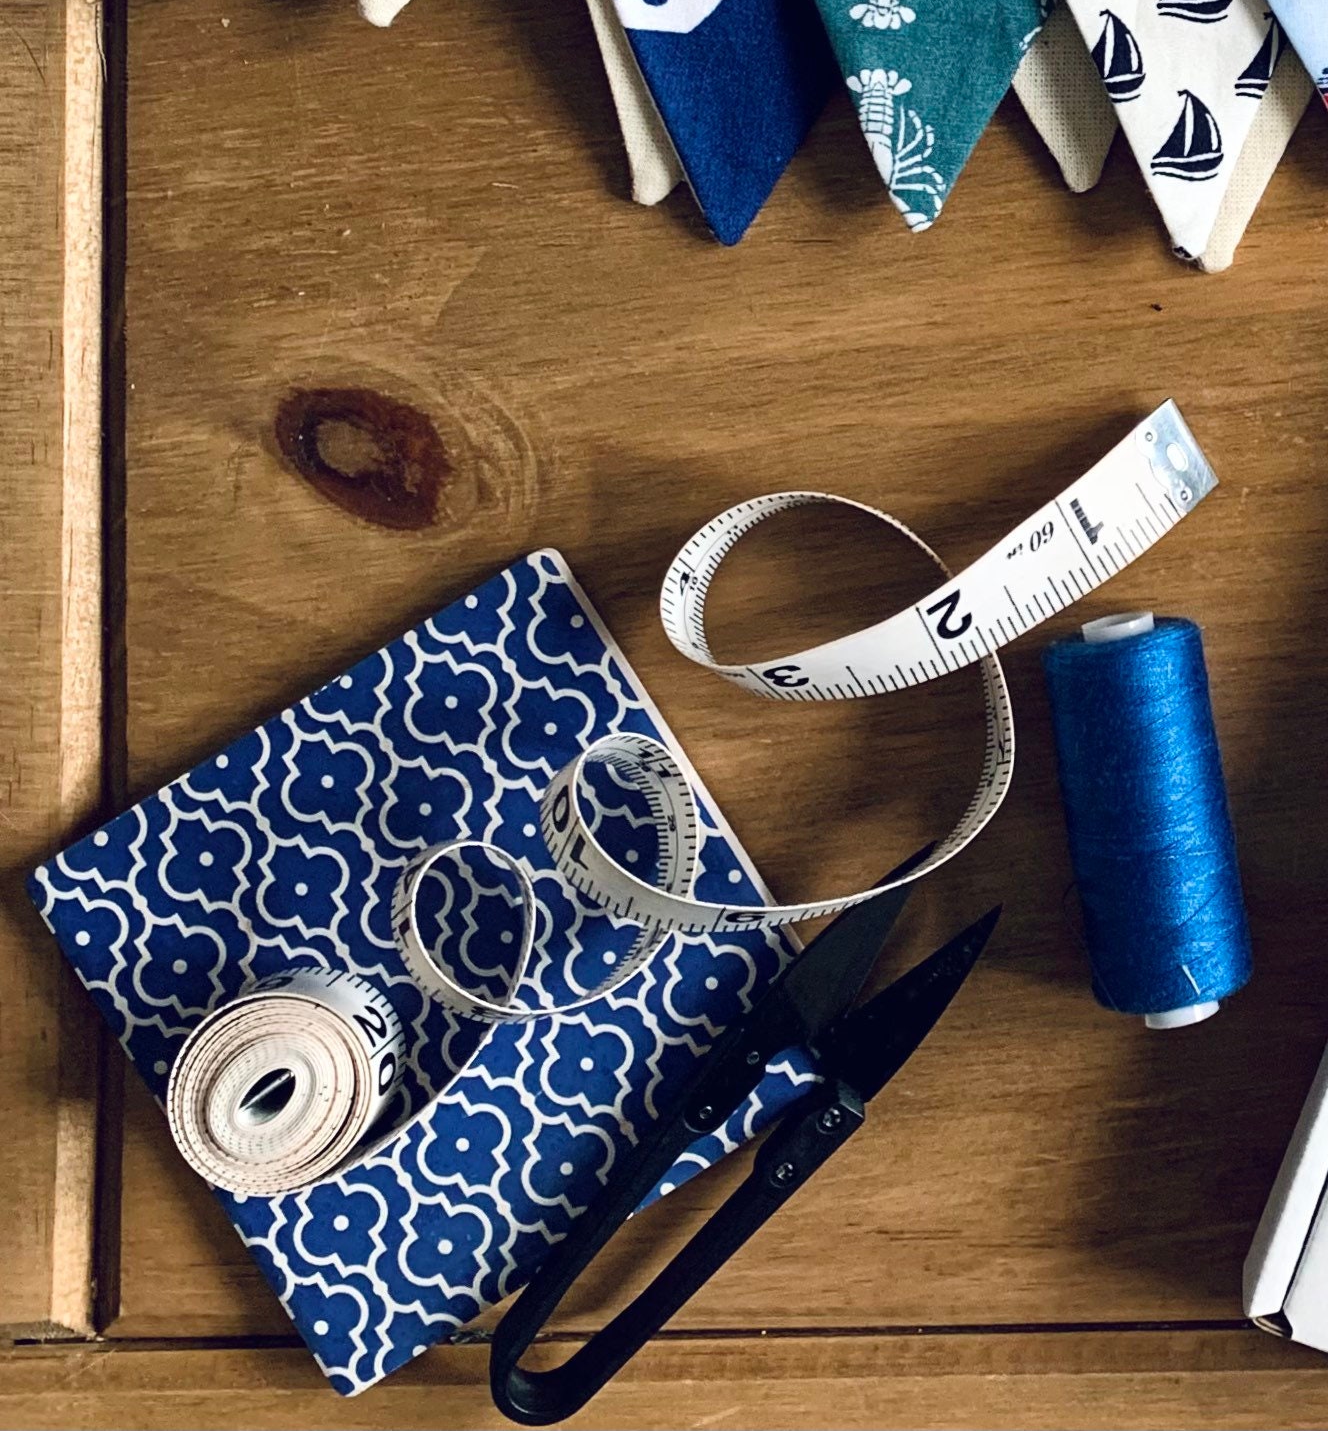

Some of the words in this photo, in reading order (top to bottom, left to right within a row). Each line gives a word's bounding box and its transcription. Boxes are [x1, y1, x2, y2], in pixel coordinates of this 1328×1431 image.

[1029, 521, 1055, 553] 60
[1069, 498, 1104, 545] 1
[679, 571, 691, 597] 4
[926, 588, 973, 640] 2
[762, 664, 809, 688] 3
[552, 784, 588, 870] 10
[352, 1005, 396, 1097] 20
